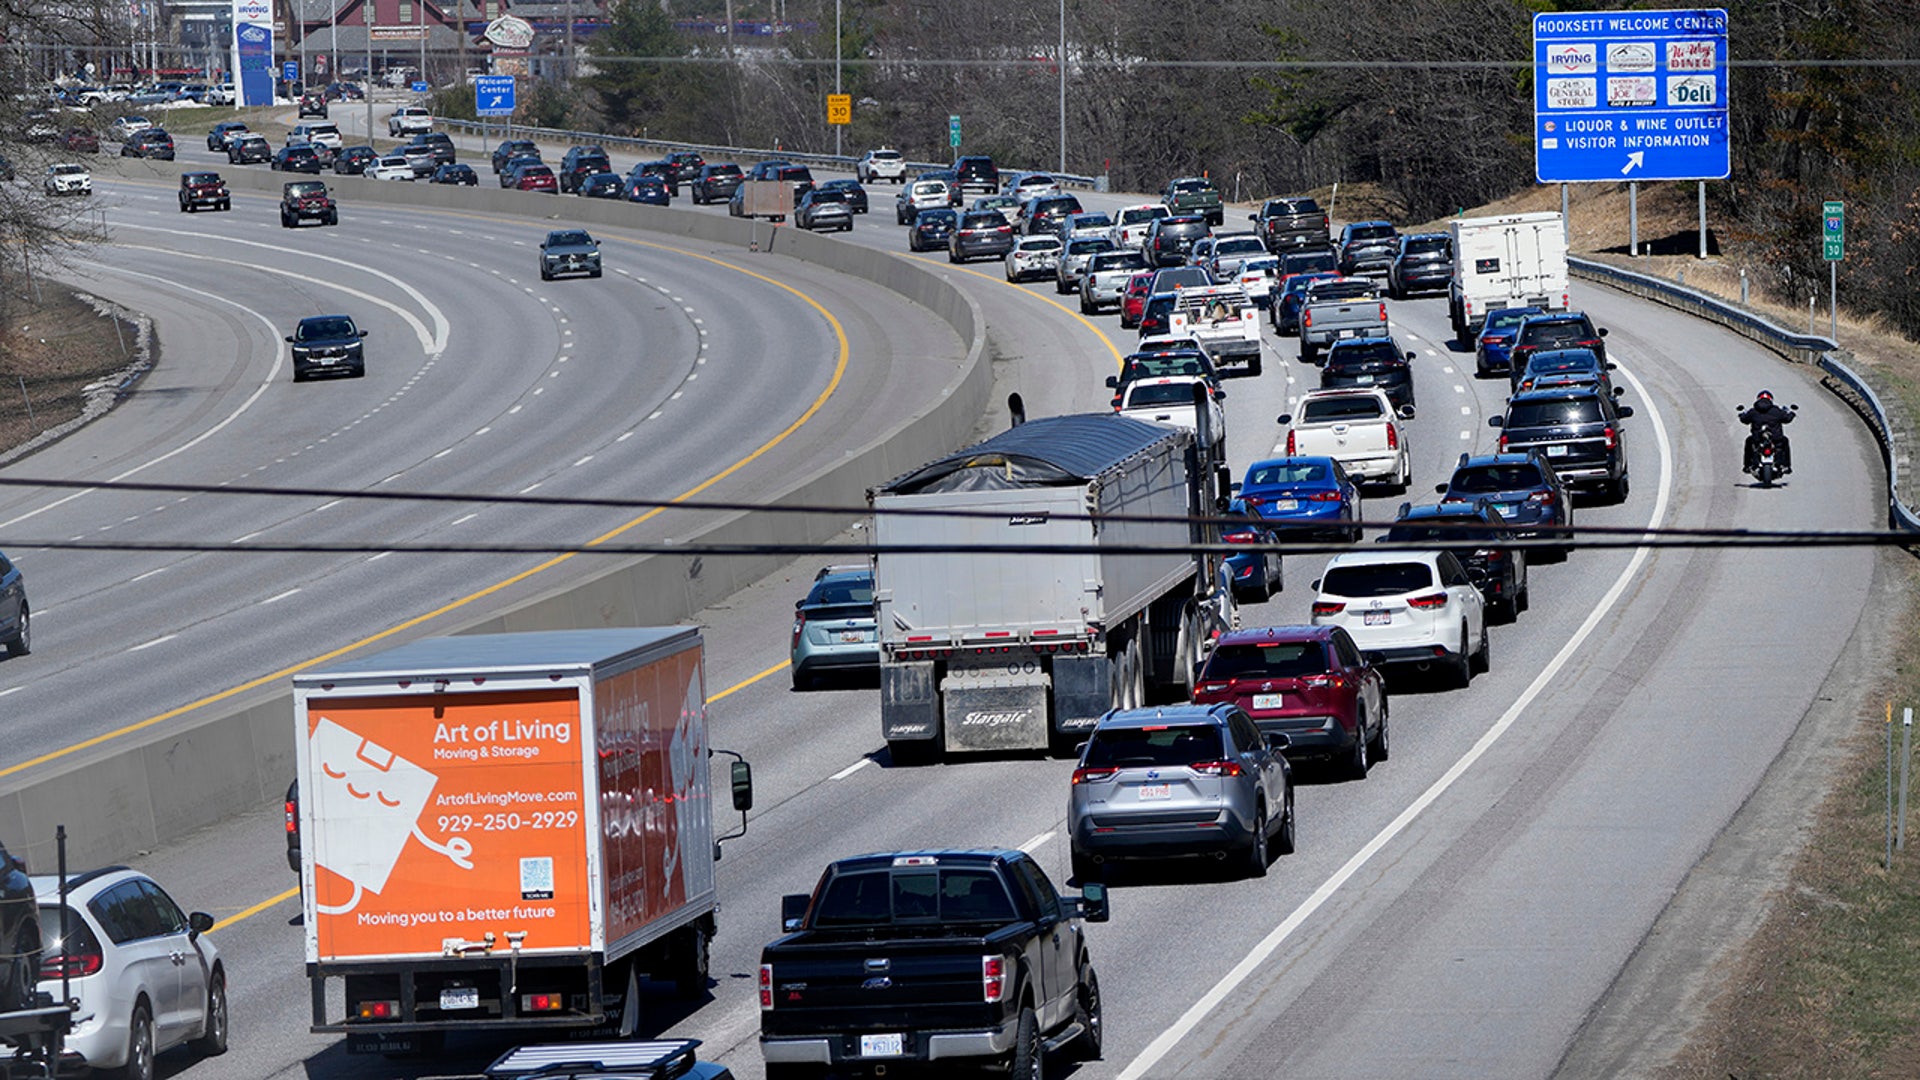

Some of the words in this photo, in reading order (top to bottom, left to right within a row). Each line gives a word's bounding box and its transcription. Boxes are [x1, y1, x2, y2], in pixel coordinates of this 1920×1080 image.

[238, 6, 268, 14] IRVING
[1538, 19, 1604, 33] HOOKSETT
[1609, 18, 1669, 30] WELCOME
[1674, 16, 1724, 29] CENTER
[1551, 53, 1592, 64] IRVING
[1670, 59, 1711, 68] DINER
[1549, 87, 1594, 98] GENERAL
[1678, 85, 1711, 103] Deli
[1557, 98, 1586, 106] STORE
[832, 107, 847, 116] 30
[1565, 120, 1613, 132] LIQUOR
[1620, 120, 1628, 130] &
[1636, 118, 1667, 130] WINE
[1674, 116, 1723, 130] OUTLET
[1566, 136, 1616, 149] VISITOR
[1624, 134, 1710, 148] INFORMATION
[1828, 245, 1840, 256] 30
[962, 710, 1027, 727] Stargate
[434, 722, 468, 743] Art
[473, 720, 498, 742] of
[503, 719, 570, 744] Living
[434, 747, 478, 761] Moving
[480, 746, 489, 758] &
[491, 746, 540, 758] Storage
[436, 790, 577, 806] ArtofLivingMove.com
[437, 810, 578, 832] 929-250-2929
[357, 911, 408, 927] Moving
[410, 912, 436, 926] you
[439, 910, 454, 922] to
[456, 912, 464, 922] a
[466, 908, 511, 921] better
[512, 906, 556, 918] future
